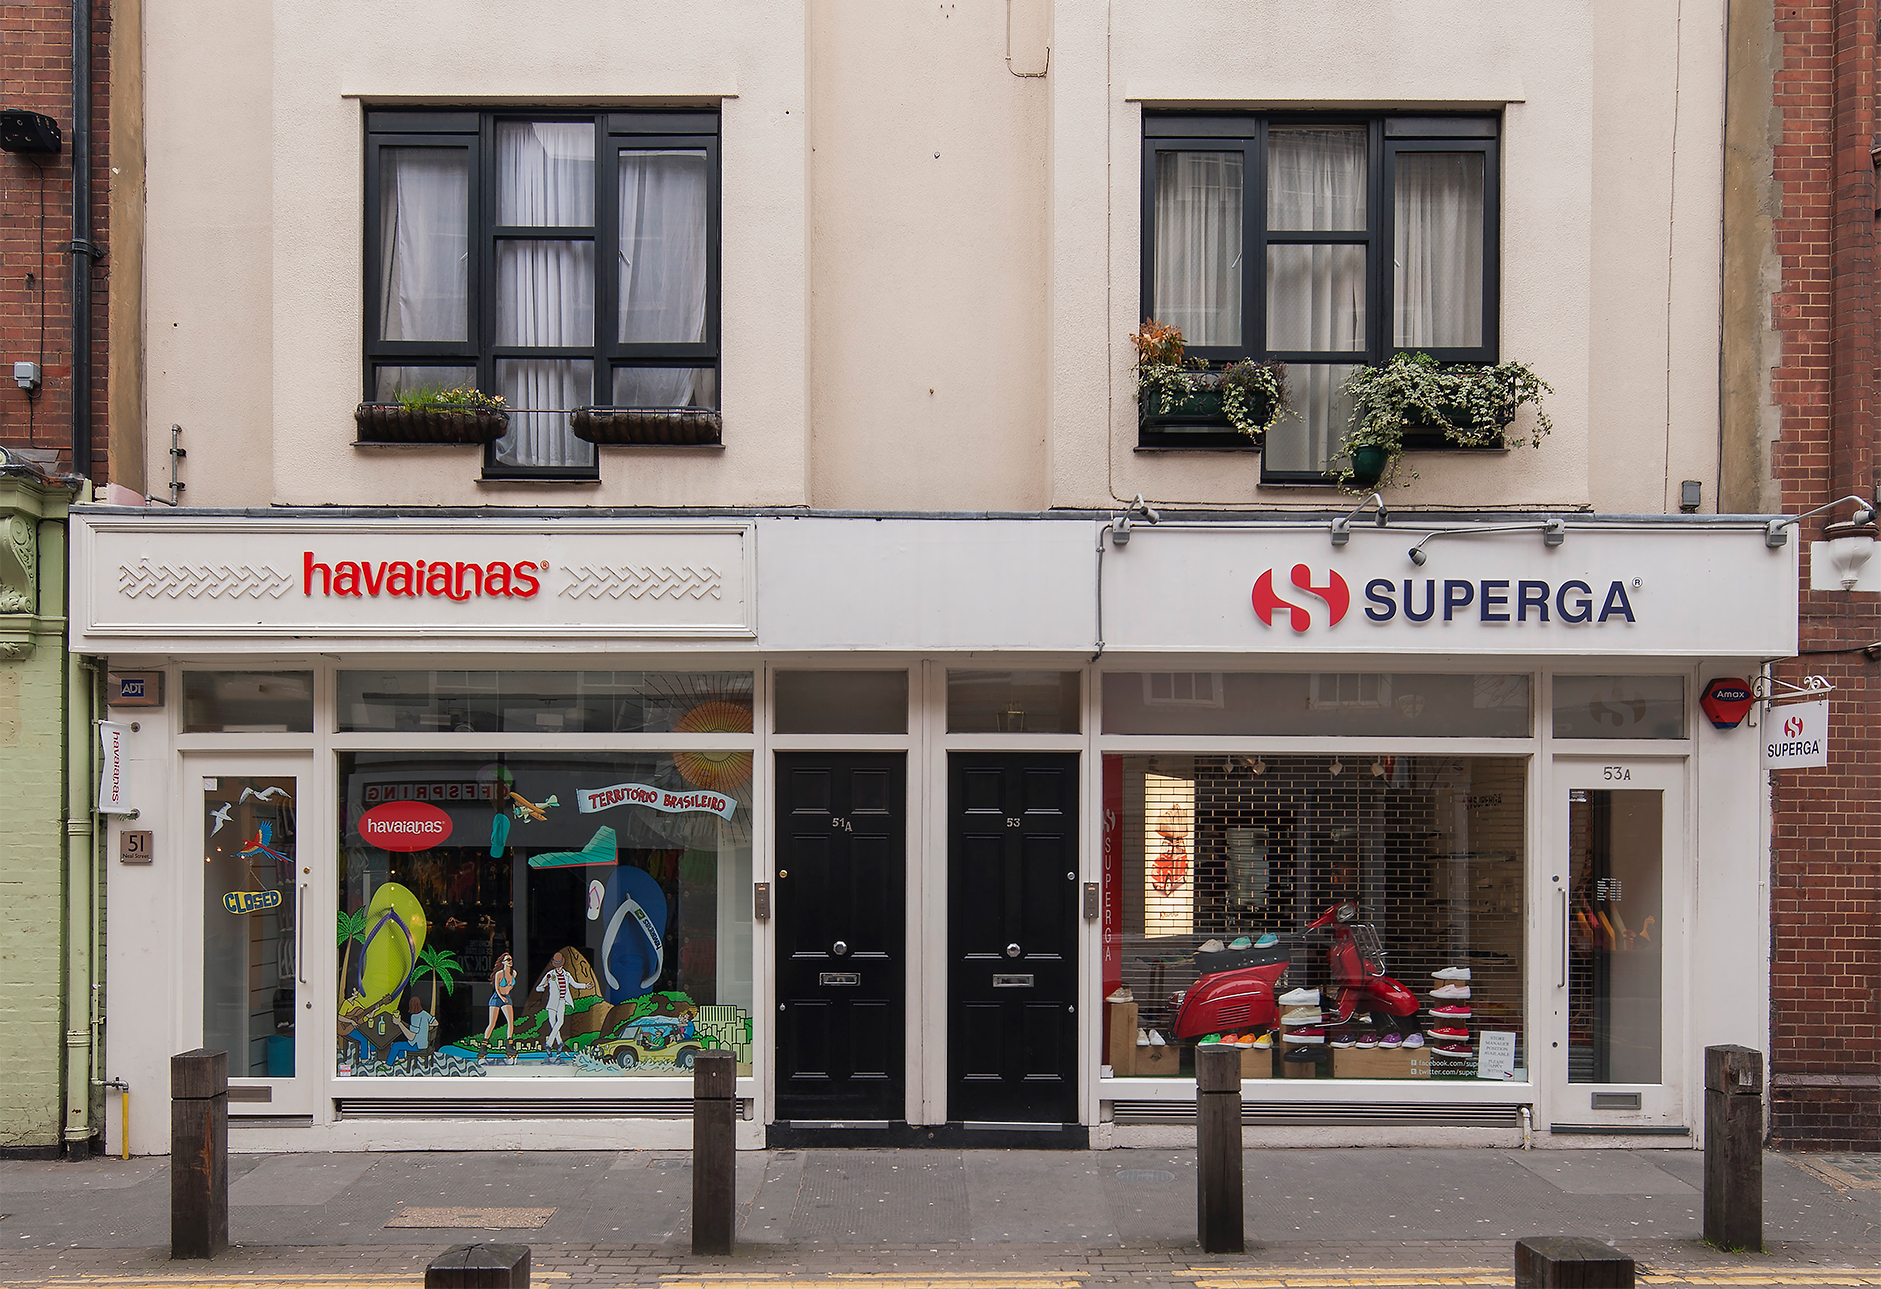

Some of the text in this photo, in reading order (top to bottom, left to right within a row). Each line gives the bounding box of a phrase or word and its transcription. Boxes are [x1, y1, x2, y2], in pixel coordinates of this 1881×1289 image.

[303, 550, 541, 601] havaianas
[1363, 578, 1637, 623] SUPERGA
[122, 683, 145, 694] ADT
[1716, 690, 1745, 698] Amax
[1767, 740, 1820, 758] SUPERGA
[111, 731, 121, 803] havaianas
[1603, 766, 1631, 781] 53A
[588, 787, 726, 812] TERRITÓRIO BRASILEIRO
[367, 818, 443, 835] havaianas
[1006, 817, 1021, 828] 53
[128, 834, 144, 852] 51
[224, 891, 280, 914] CLOSED
[1104, 837, 1112, 962] SUPERGA
